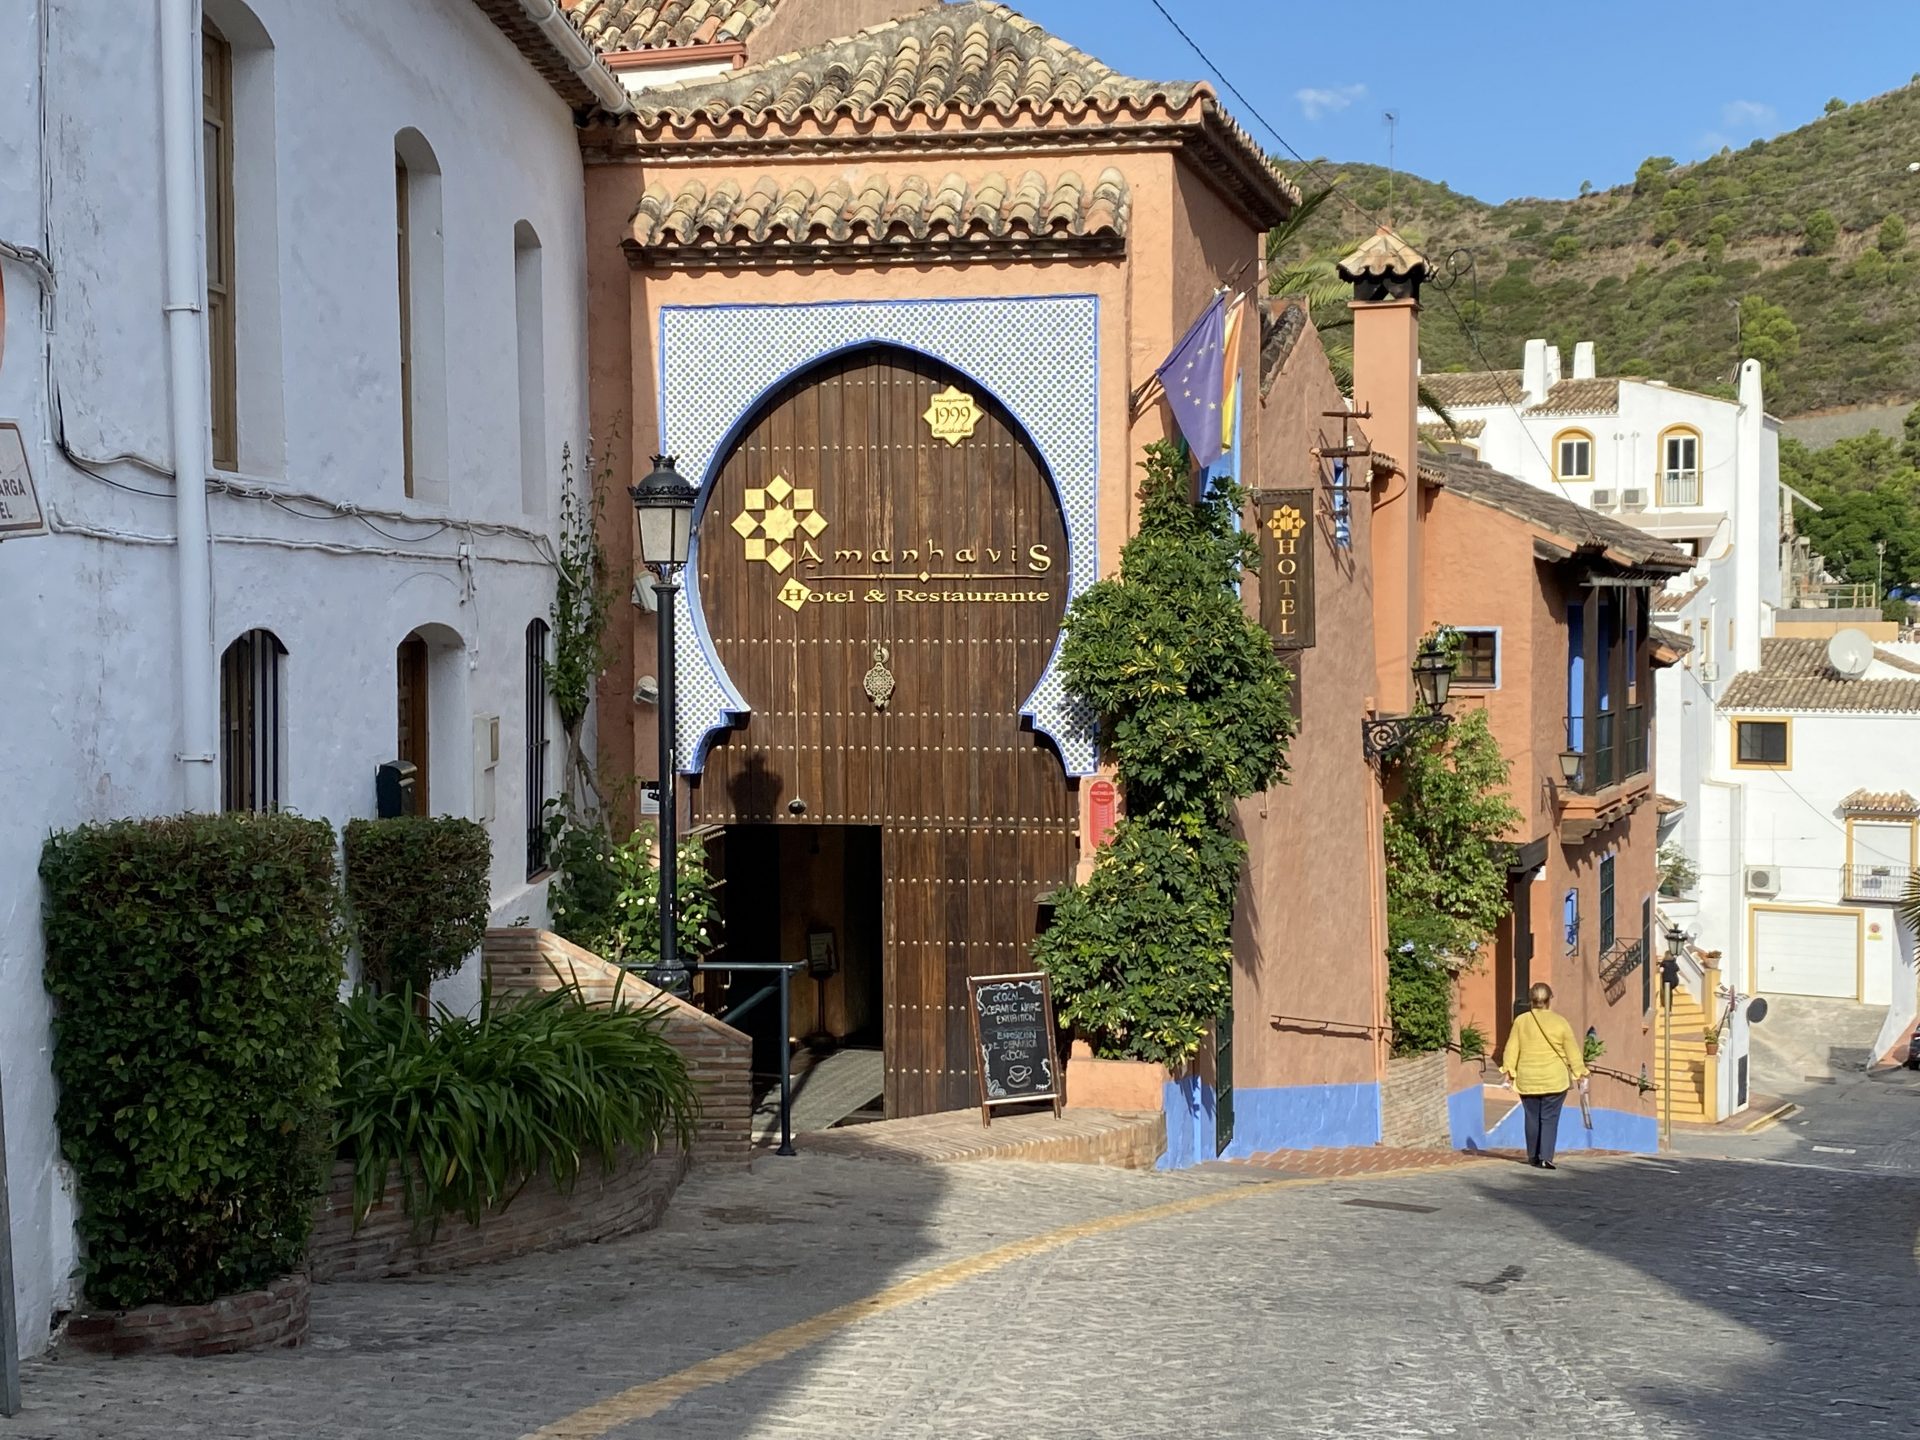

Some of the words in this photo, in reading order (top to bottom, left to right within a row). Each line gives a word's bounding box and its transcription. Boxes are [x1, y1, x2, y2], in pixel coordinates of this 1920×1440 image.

[935, 406, 971, 426] 1999
[784, 588, 856, 603] Hotel
[863, 589, 888, 603] &
[896, 589, 1050, 603] Restaurante
[1277, 539, 1297, 635] HOTEL
